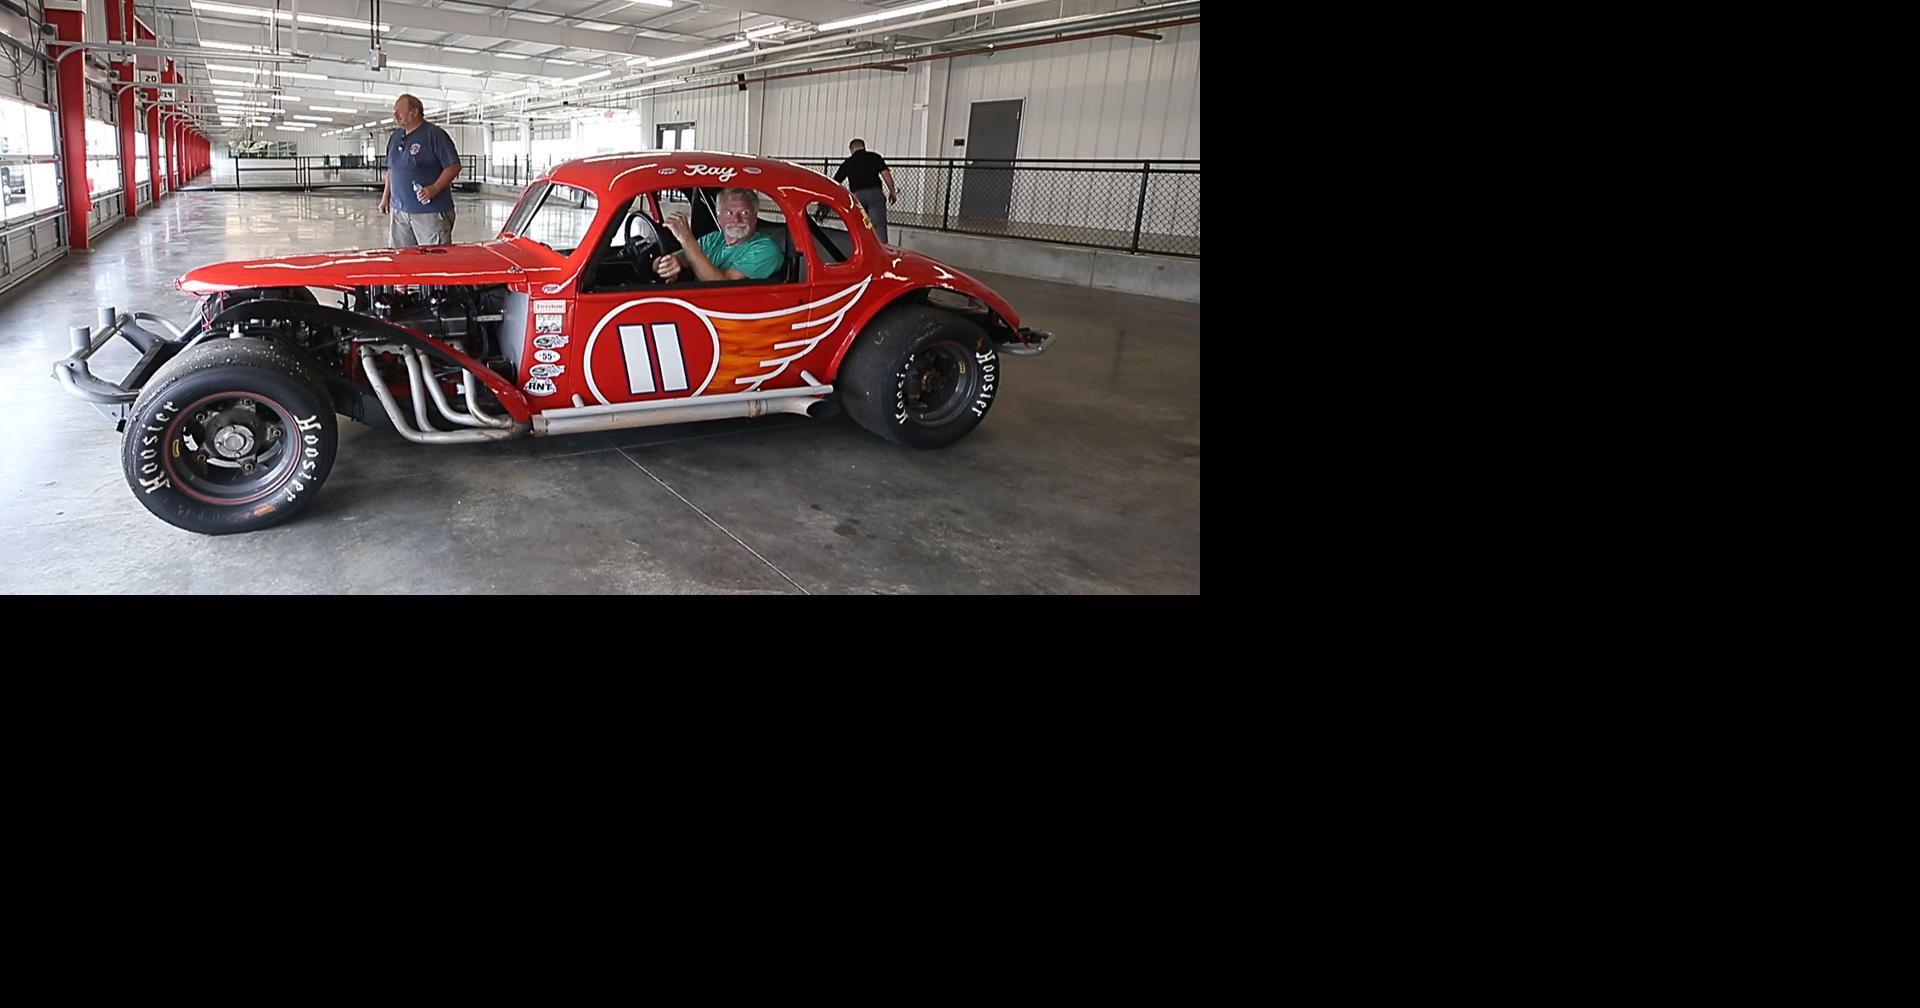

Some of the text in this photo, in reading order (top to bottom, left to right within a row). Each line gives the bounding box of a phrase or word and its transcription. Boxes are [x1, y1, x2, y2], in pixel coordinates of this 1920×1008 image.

[683, 164, 738, 182] Ray
[542, 352, 552, 360] 55
[617, 322, 690, 395] 11
[895, 354, 915, 424] Hoosier
[972, 349, 995, 417] Hoosier
[139, 400, 179, 494] Hoosier
[287, 414, 322, 503] Hoosier
